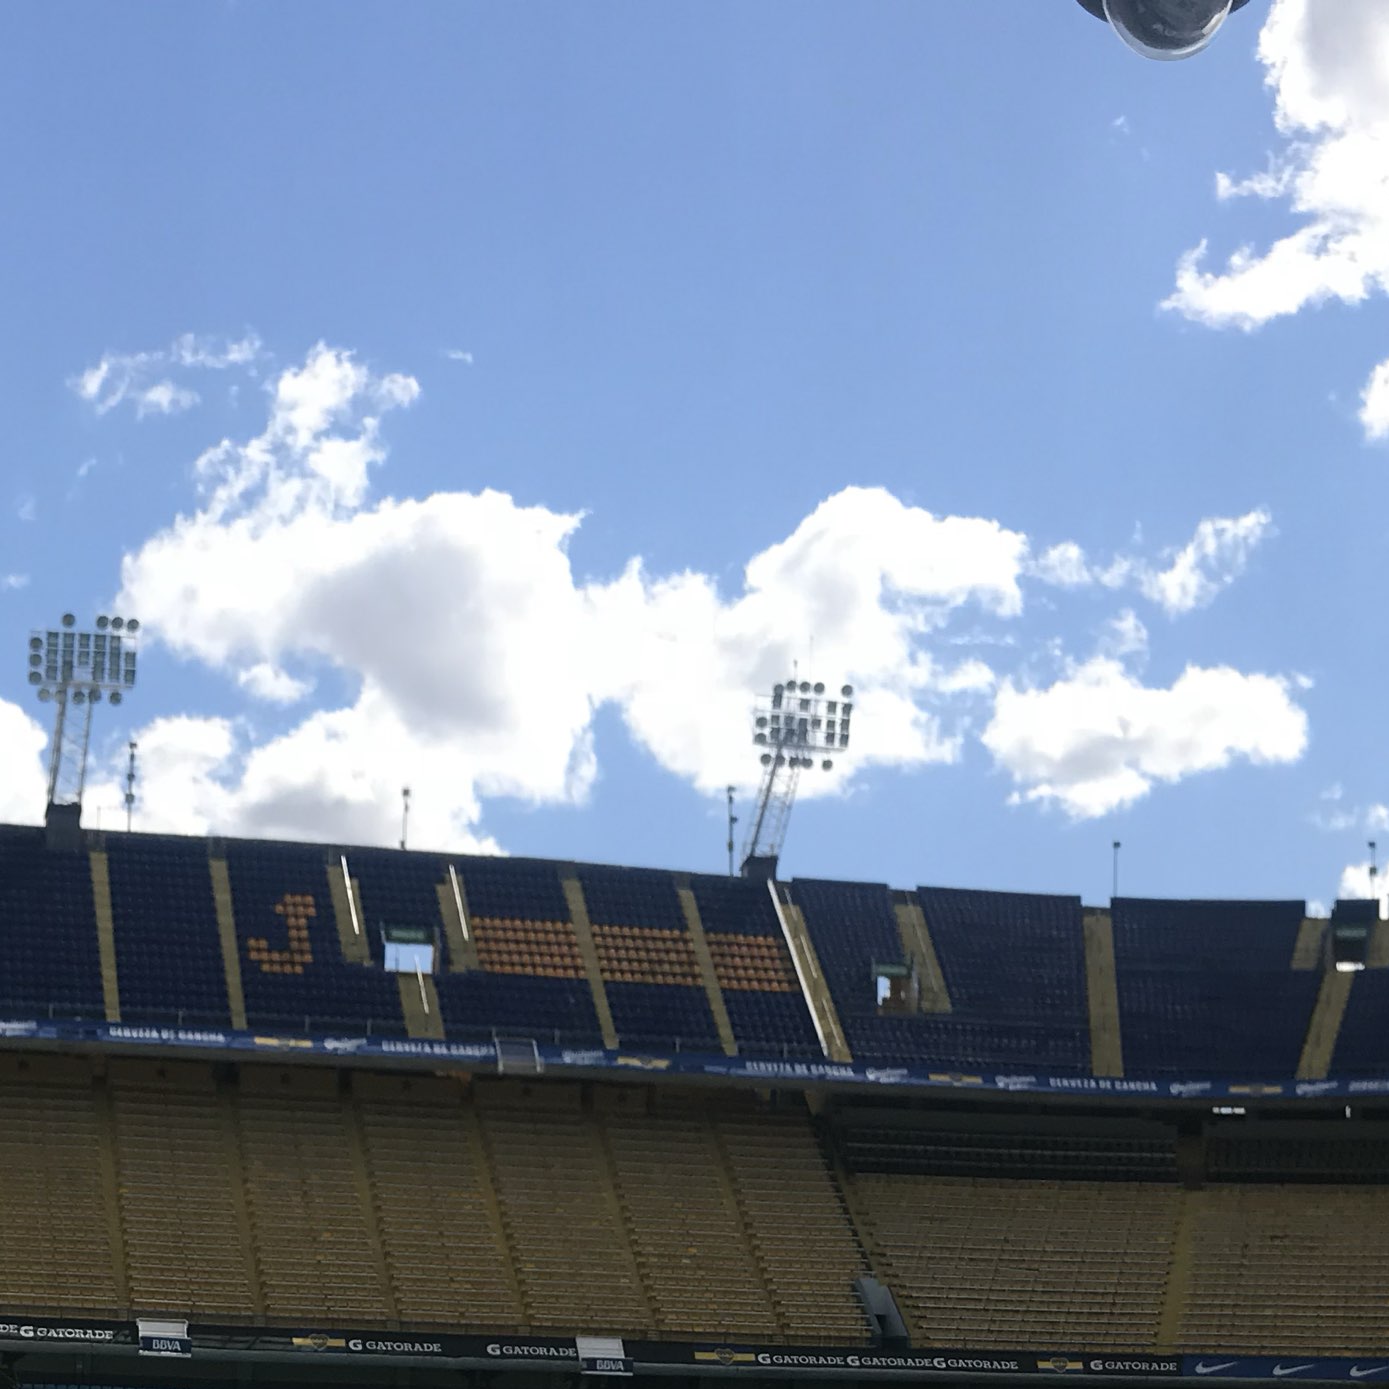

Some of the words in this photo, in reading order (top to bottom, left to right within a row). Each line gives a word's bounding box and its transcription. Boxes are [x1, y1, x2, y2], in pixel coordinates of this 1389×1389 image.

[37, 1328, 114, 1339] GATORADE
[152, 1339, 181, 1351] BBVA
[366, 1341, 442, 1352] GATORADE
[503, 1346, 577, 1356] GATORADE
[596, 1360, 624, 1370] BBVA
[773, 1355, 845, 1365] GATORADE
[861, 1357, 933, 1367] GATORADE
[948, 1359, 1018, 1370] GATORADE
[1105, 1361, 1177, 1371] GATORADE
